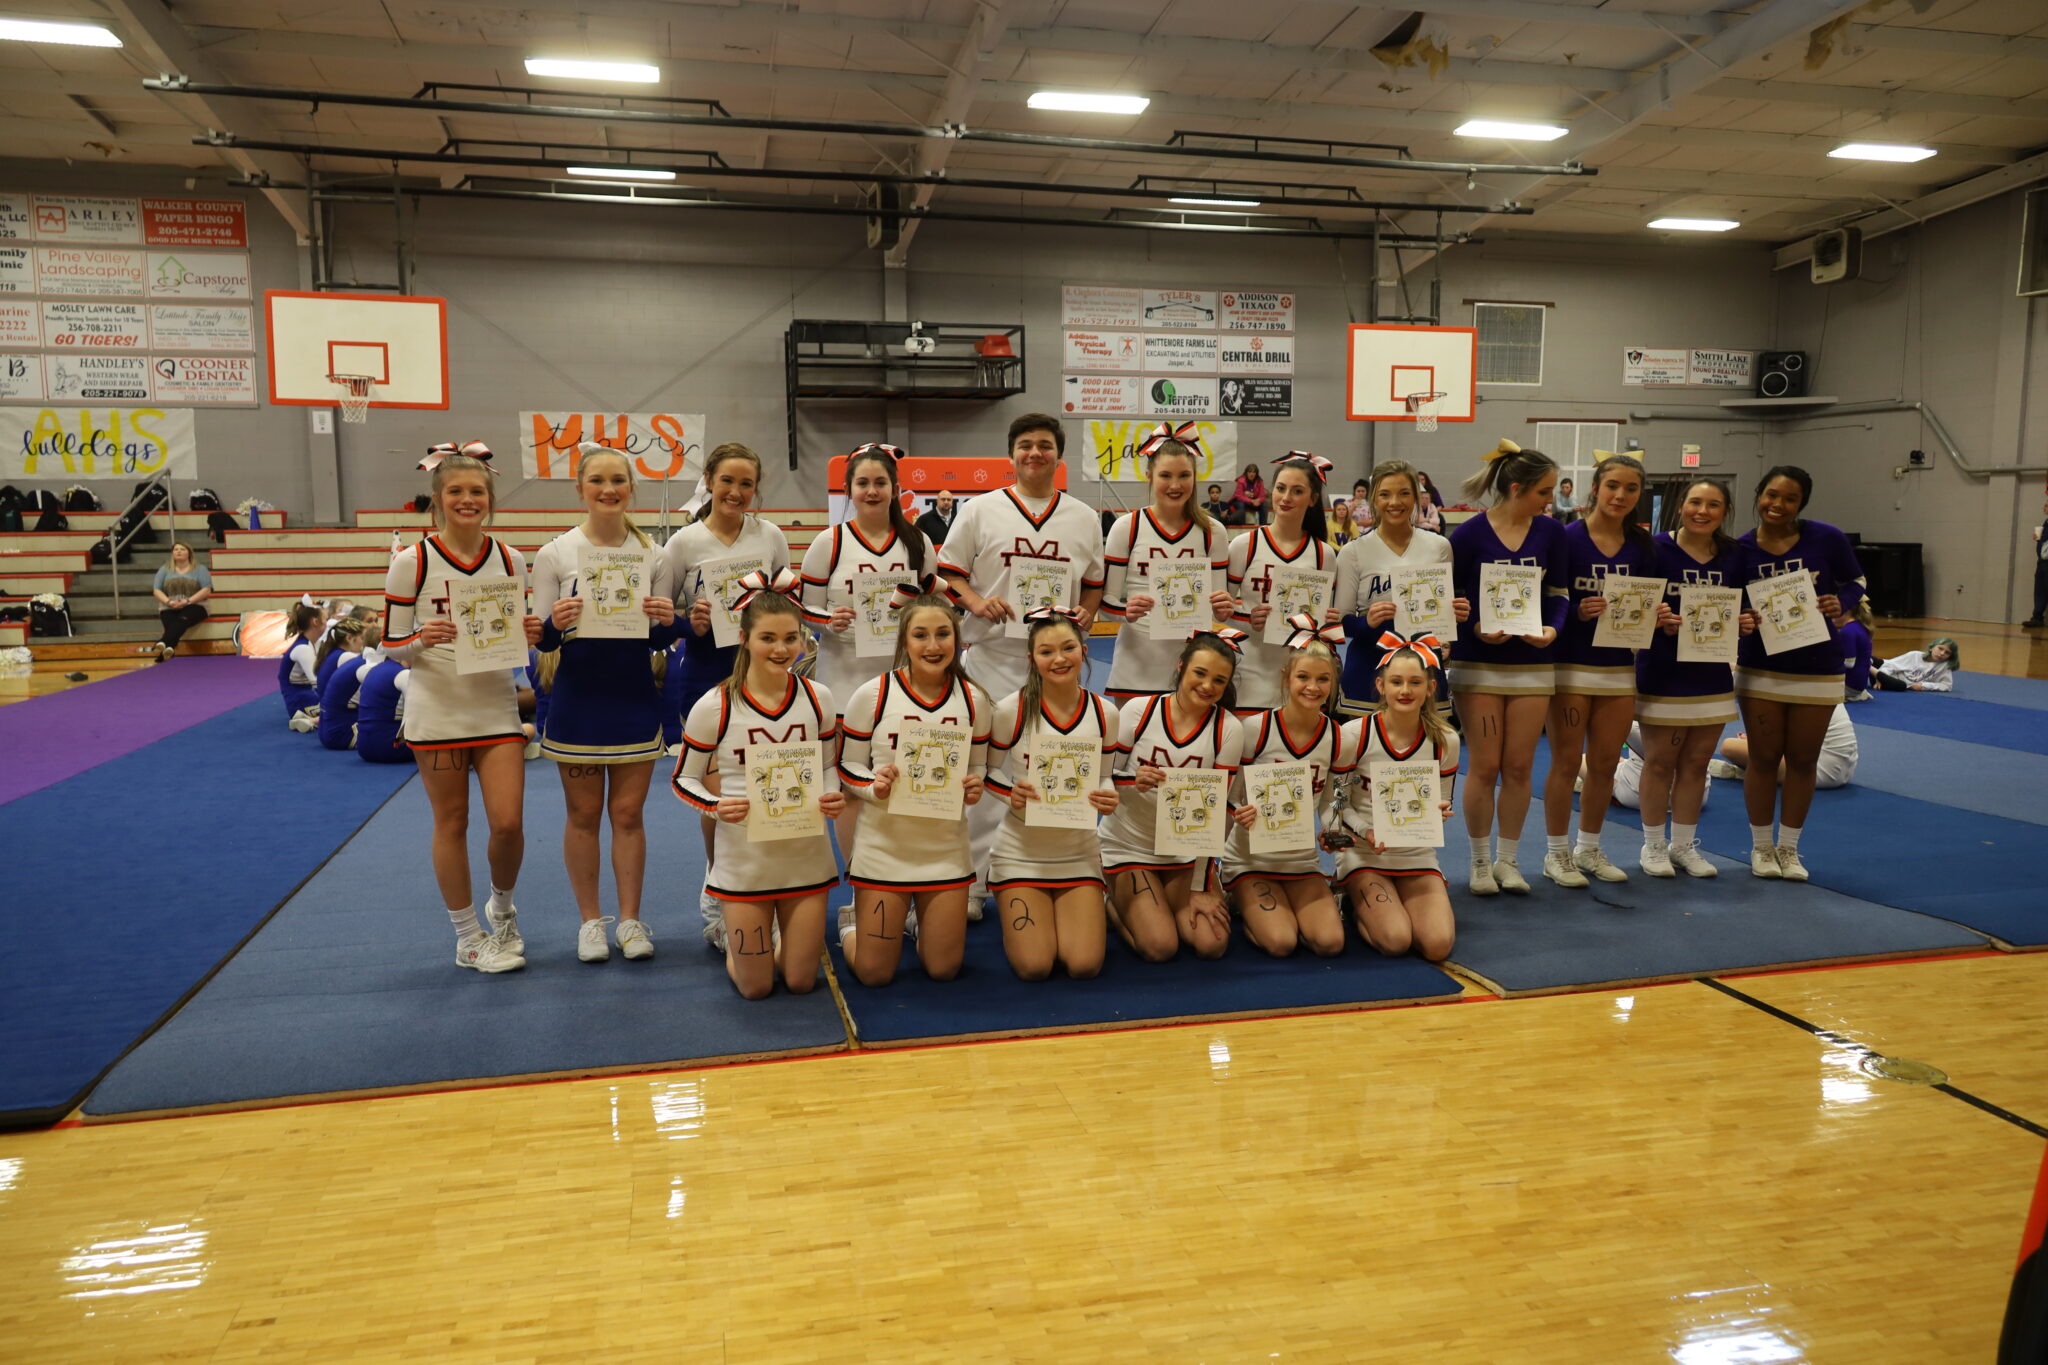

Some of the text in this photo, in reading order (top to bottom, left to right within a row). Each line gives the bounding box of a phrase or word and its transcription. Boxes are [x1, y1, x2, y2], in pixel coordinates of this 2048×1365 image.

[143, 200, 243, 212] WALKER COUNTY
[9, 214, 28, 222] LLC
[67, 209, 136, 222] ARLEY
[154, 213, 234, 224] PAPER BINGO
[48, 250, 131, 266] Pine Valley
[40, 263, 141, 280] Landscaping
[183, 272, 247, 287] Capstone
[1158, 291, 1201, 302] TYLER'S
[1237, 293, 1279, 301] ADDISON
[52, 304, 136, 314] MOSLEY LAWN CARE
[1241, 302, 1276, 310] TEXACO
[68, 323, 122, 333] 256-708-2211
[54, 333, 139, 347] GO TIGERS!
[1074, 340, 1106, 348] Physical
[1145, 338, 1217, 348] WHITTEMORE FARMS LLC
[1082, 347, 1113, 356] Therapy
[1146, 350, 1180, 358] EXCAVATING
[1191, 351, 1216, 359] UTILITIES
[1222, 351, 1291, 363] CENTRAL DRILL
[1694, 350, 1749, 362] SMITH LAKE
[79, 358, 145, 369] HANDLEY'S
[179, 359, 249, 370] COONER
[1697, 361, 1745, 369] PROPERTIES
[86, 371, 119, 379] WESTERN
[185, 371, 247, 381] DENTAL
[1082, 378, 1102, 386] GOOD
[1167, 394, 1209, 406] TerraPro
[23, 408, 169, 475] AHS
[532, 413, 685, 479] MHS
[20, 429, 159, 474] bulldogs
[1685, 455, 1698, 465] EXIT
[1562, 706, 1580, 728] 10
[1482, 714, 1497, 738] 11
[1130, 870, 1159, 906] 4
[1252, 881, 1277, 912] 3
[1359, 881, 1392, 909] 12
[867, 899, 897, 940] 1
[1009, 897, 1035, 931] 2
[734, 925, 770, 956] 21
